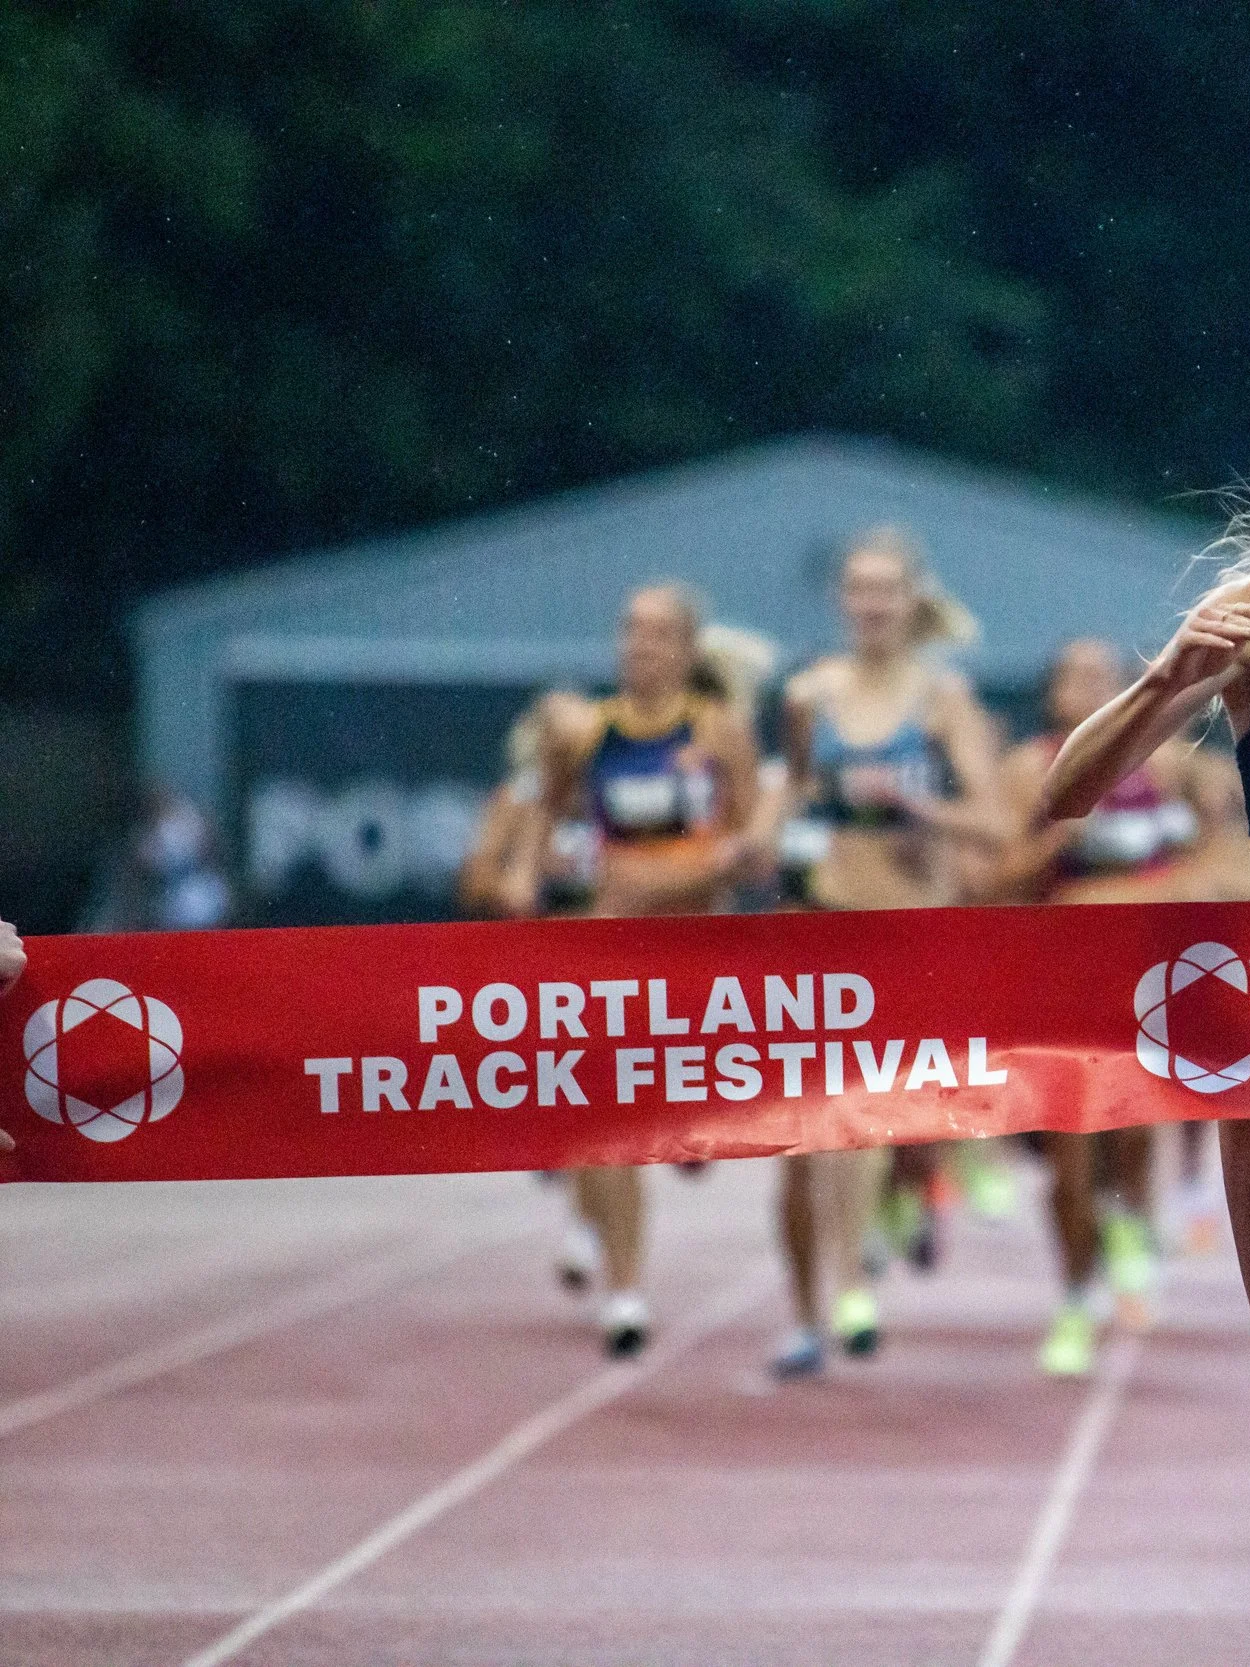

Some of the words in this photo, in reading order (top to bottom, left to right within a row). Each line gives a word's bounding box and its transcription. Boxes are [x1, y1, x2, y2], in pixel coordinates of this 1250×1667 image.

[418, 973, 875, 1043] PORTLAND
[304, 1050, 589, 1113] TRACK
[616, 1036, 1009, 1104] FESTIVAL
